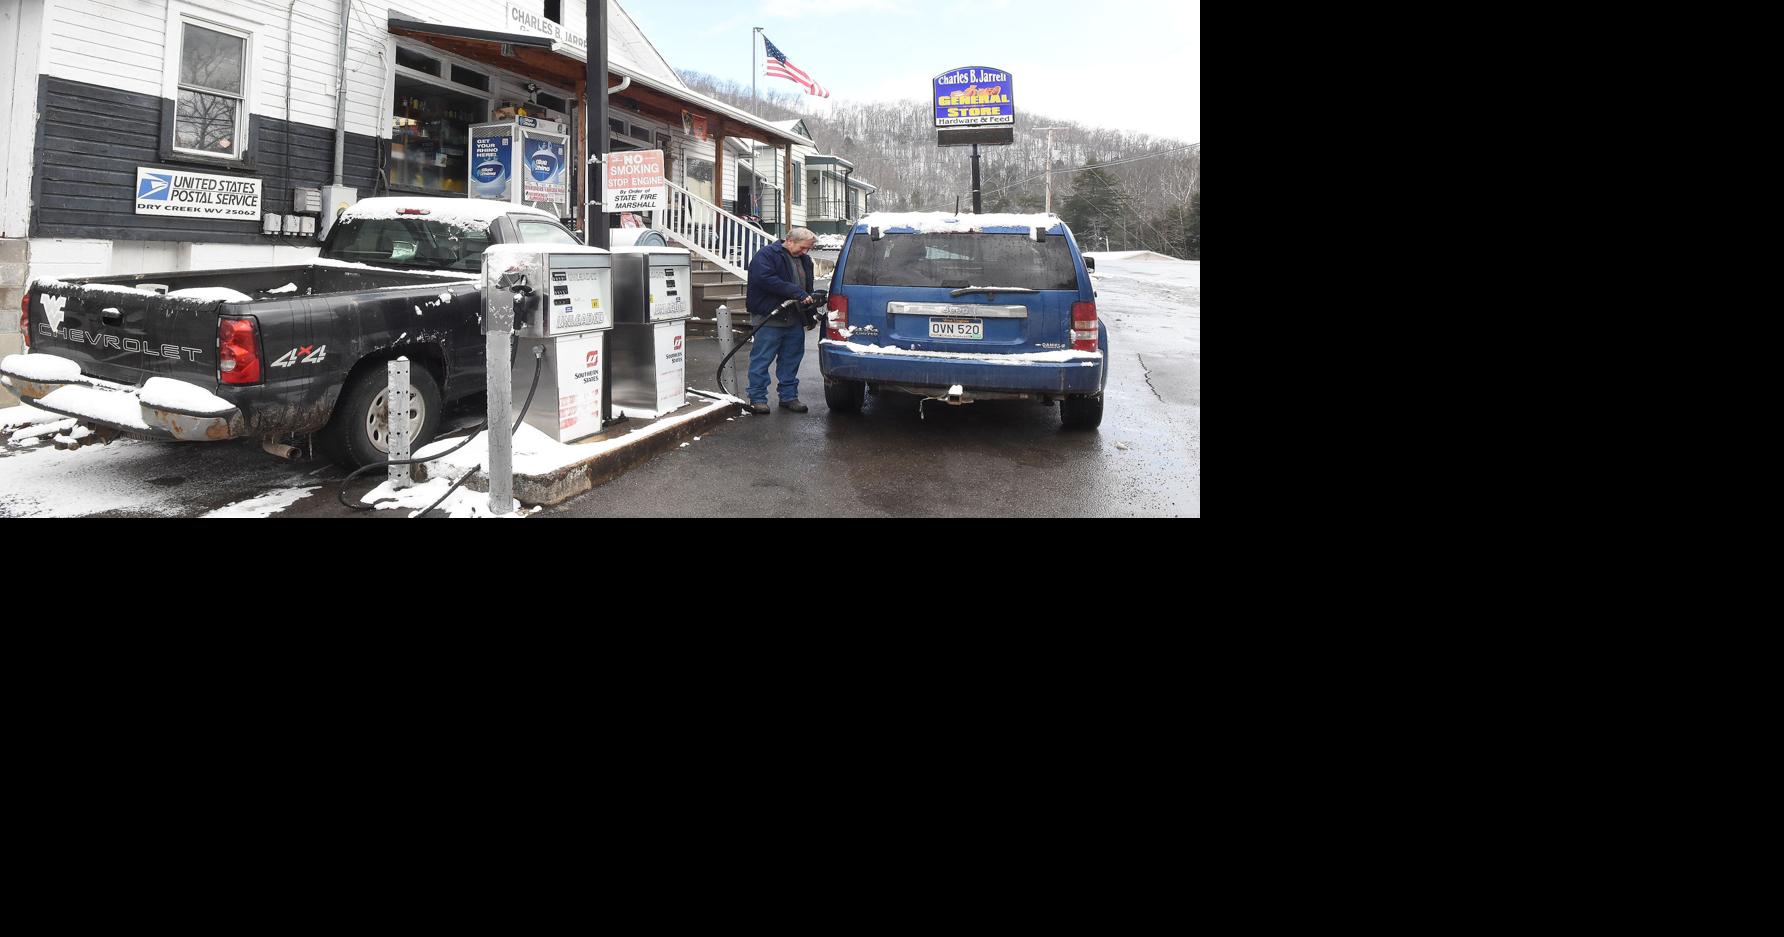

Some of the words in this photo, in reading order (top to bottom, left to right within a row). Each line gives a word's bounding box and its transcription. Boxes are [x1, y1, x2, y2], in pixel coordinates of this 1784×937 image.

[512, 7, 553, 36] CHARLES
[938, 71, 969, 85] Charles
[970, 69, 979, 83] B.
[938, 94, 1010, 106] GENERAL
[947, 107, 1001, 118] STORE
[938, 117, 979, 125] Hardware
[989, 115, 1010, 123] Feed
[623, 155, 644, 165] NO
[610, 163, 660, 176] SMOKING
[173, 175, 217, 191] UNITED
[219, 180, 256, 194] STATES
[608, 177, 629, 187] STOP
[631, 175, 663, 186] ENGINE
[170, 189, 213, 204] POSTAL
[215, 193, 259, 207] SERVICE
[614, 194, 637, 202] STATE
[164, 205, 201, 213] CREEK
[615, 201, 656, 209] MARSHALL
[932, 323, 954, 334] OVN
[957, 324, 980, 335] 520
[38, 322, 203, 362] CHEVROLET
